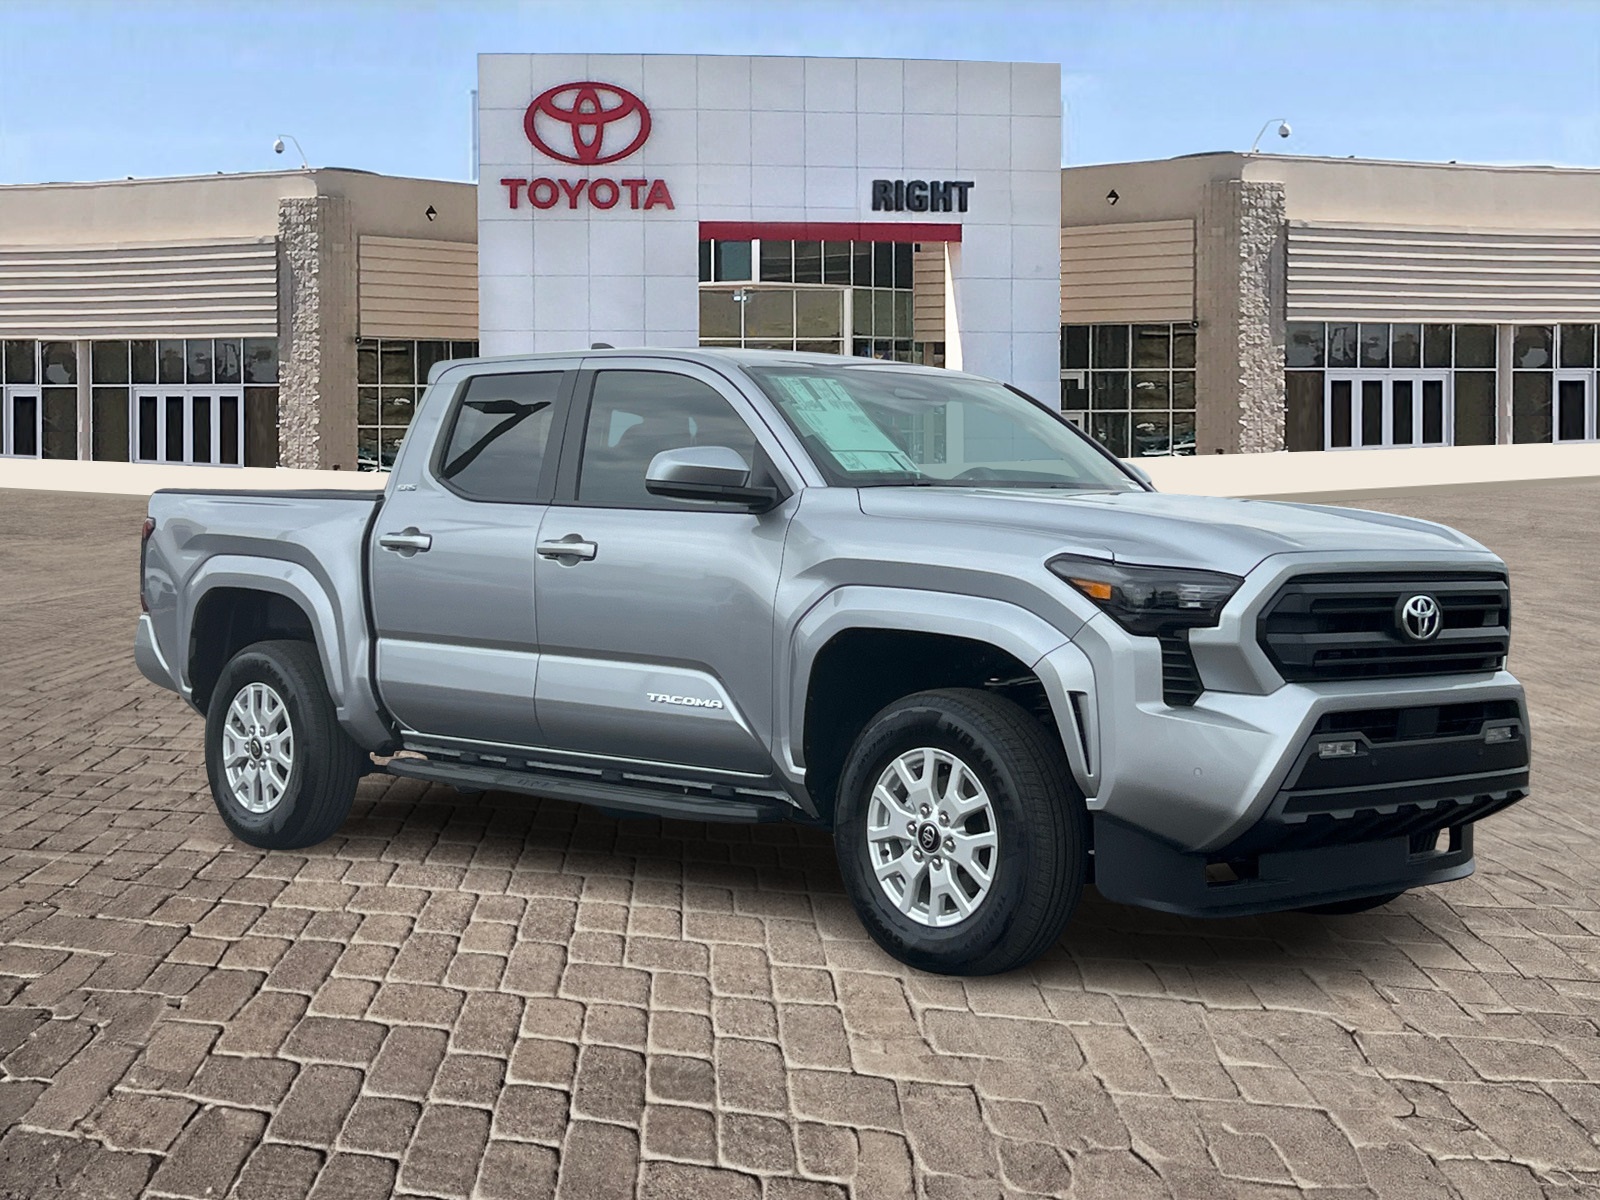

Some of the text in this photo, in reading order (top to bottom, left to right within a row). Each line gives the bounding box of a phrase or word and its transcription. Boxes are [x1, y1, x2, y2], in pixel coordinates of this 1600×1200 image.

[500, 178, 675, 209] TOYOTA
[871, 180, 975, 212] RIGHT
[646, 692, 724, 709] TACOMA
